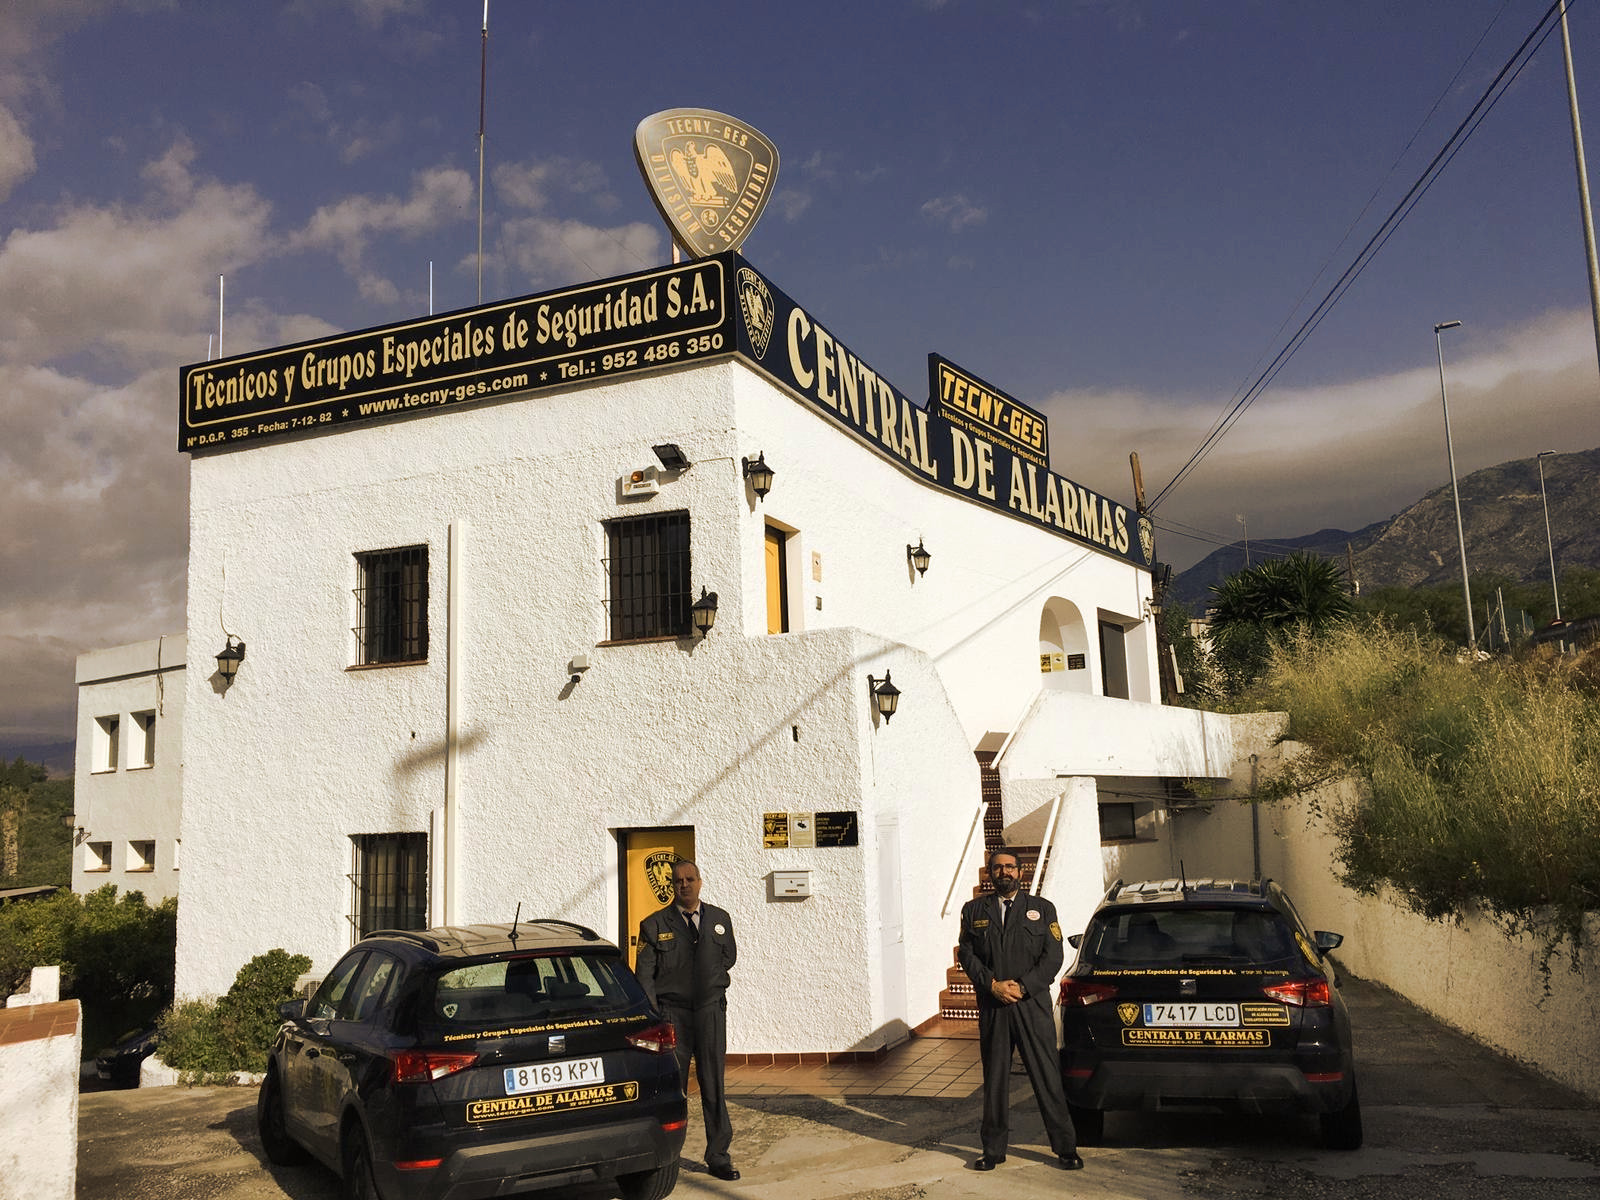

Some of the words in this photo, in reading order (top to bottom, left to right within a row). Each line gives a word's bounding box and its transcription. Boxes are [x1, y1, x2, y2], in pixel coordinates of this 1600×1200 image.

[651, 153, 701, 234] DIVISION
[719, 163, 768, 243] SEGURIDAD
[283, 364, 296, 403] y
[301, 349, 376, 391] Grupos
[382, 319, 495, 378] Especiales
[502, 310, 529, 351] de
[536, 281, 658, 348] Seguridad
[666, 272, 715, 318] S.A.
[557, 359, 596, 380] Tel.:
[602, 349, 638, 371] 952
[643, 341, 680, 362] 486
[686, 333, 724, 355] 350
[359, 372, 529, 416] www.tecny-ges.com
[942, 369, 1044, 449] TECNY-GES
[199, 431, 226, 445] D.G.P.
[231, 426, 249, 439] 355
[257, 420, 289, 435] Fecha:
[787, 307, 938, 481] CENTRAL
[950, 425, 996, 501] DE
[1008, 455, 1129, 555] ALARMAS
[443, 1033, 476, 1041] Técnicos
[482, 1030, 509, 1038] Grupos
[510, 1025, 545, 1034] Especiales
[555, 1020, 589, 1030] Seguridad
[1128, 1030, 1183, 1040] CENTRAL
[1185, 1031, 1201, 1040] DE
[1204, 1031, 1264, 1041] ALARMAS
[1155, 1006, 1198, 1021] 7417
[1203, 1006, 1236, 1022] LCD
[518, 1065, 563, 1087] 8169
[568, 1060, 599, 1080] KPY
[472, 1097, 533, 1115] CENTRAL
[535, 1094, 553, 1107] DE
[555, 1086, 614, 1104] ALARMAS
